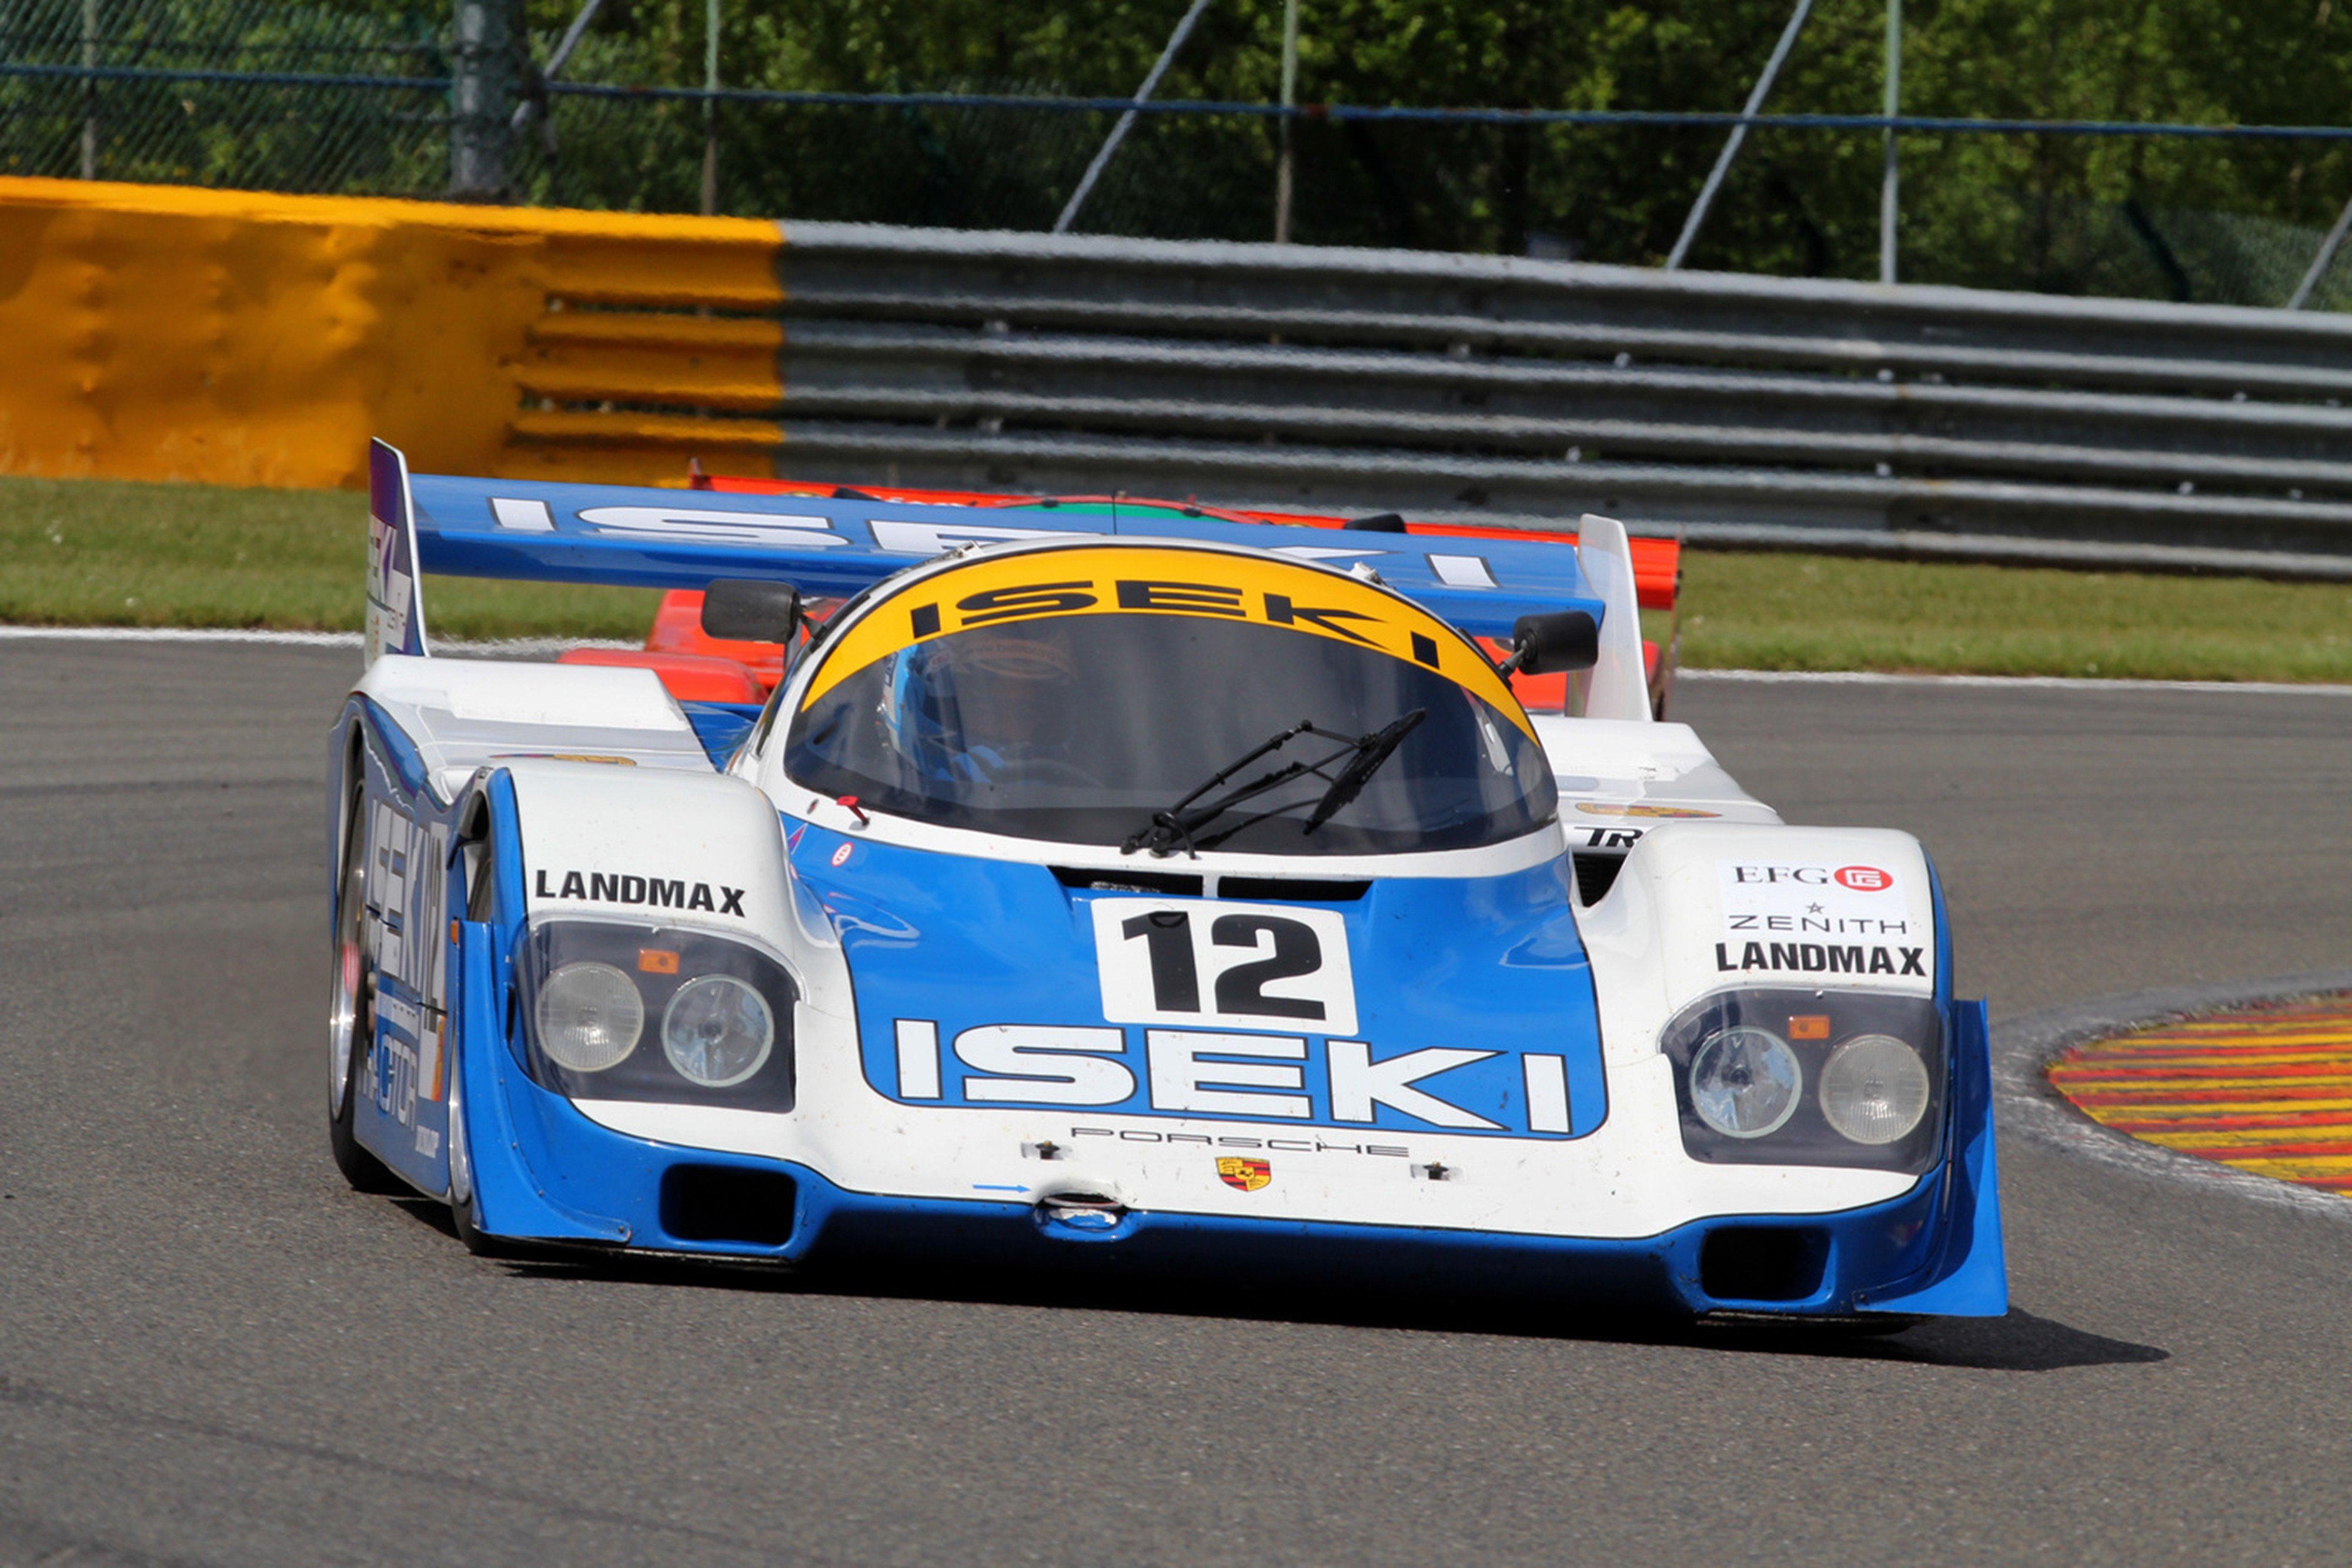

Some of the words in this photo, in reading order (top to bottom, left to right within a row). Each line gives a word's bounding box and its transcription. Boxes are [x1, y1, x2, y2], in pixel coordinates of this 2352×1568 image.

[910, 580, 1440, 670] ISEKI
[1573, 826, 1644, 848] TR
[1732, 865, 1829, 884] EFG
[535, 869, 746, 918] LANDMAX
[1728, 915, 1907, 935] ZENITH
[1121, 911, 1327, 1021] 12
[1715, 941, 1927, 977] LANDMAX
[893, 1017, 1574, 1135] ISEKI
[1071, 1127, 1409, 1158] PORSCHE
